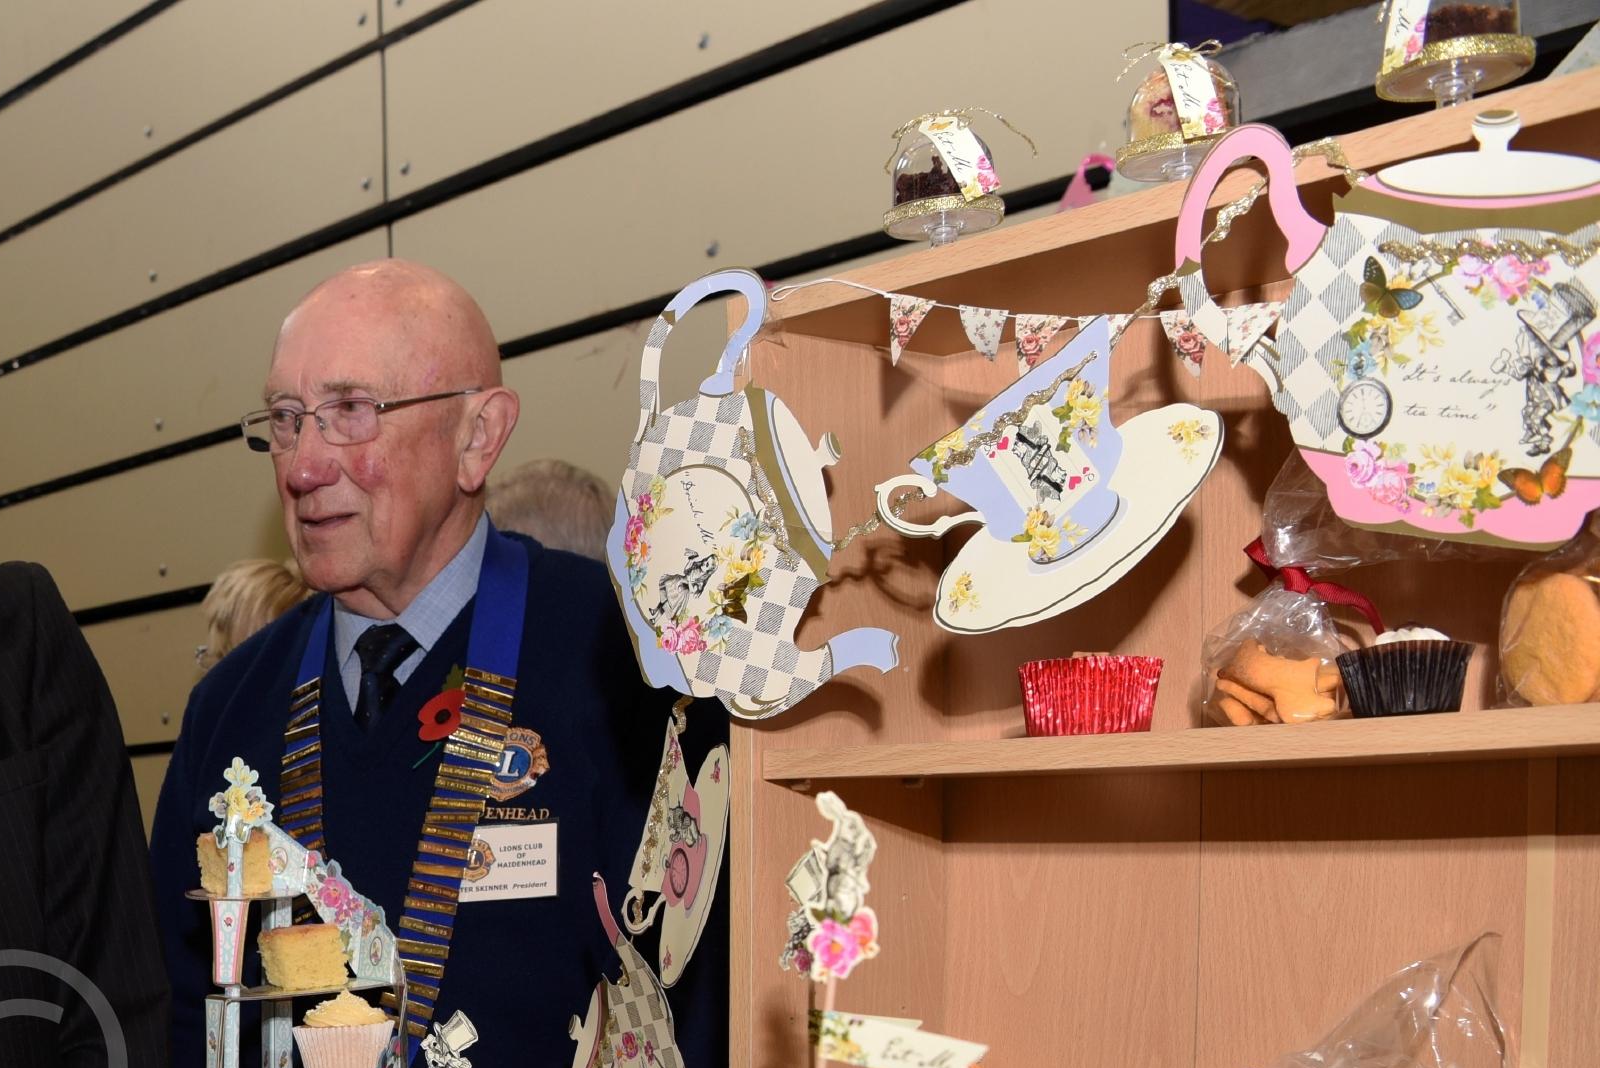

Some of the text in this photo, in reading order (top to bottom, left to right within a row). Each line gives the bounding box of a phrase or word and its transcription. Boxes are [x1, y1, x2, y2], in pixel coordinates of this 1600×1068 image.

[1450, 369, 1512, 399] always
[1403, 403, 1428, 417] tea
[499, 842, 543, 852] LIONS CLUB
[497, 858, 547, 868] MAIDENHEAD
[475, 884, 508, 892] SKINNER
[512, 881, 547, 889] President
